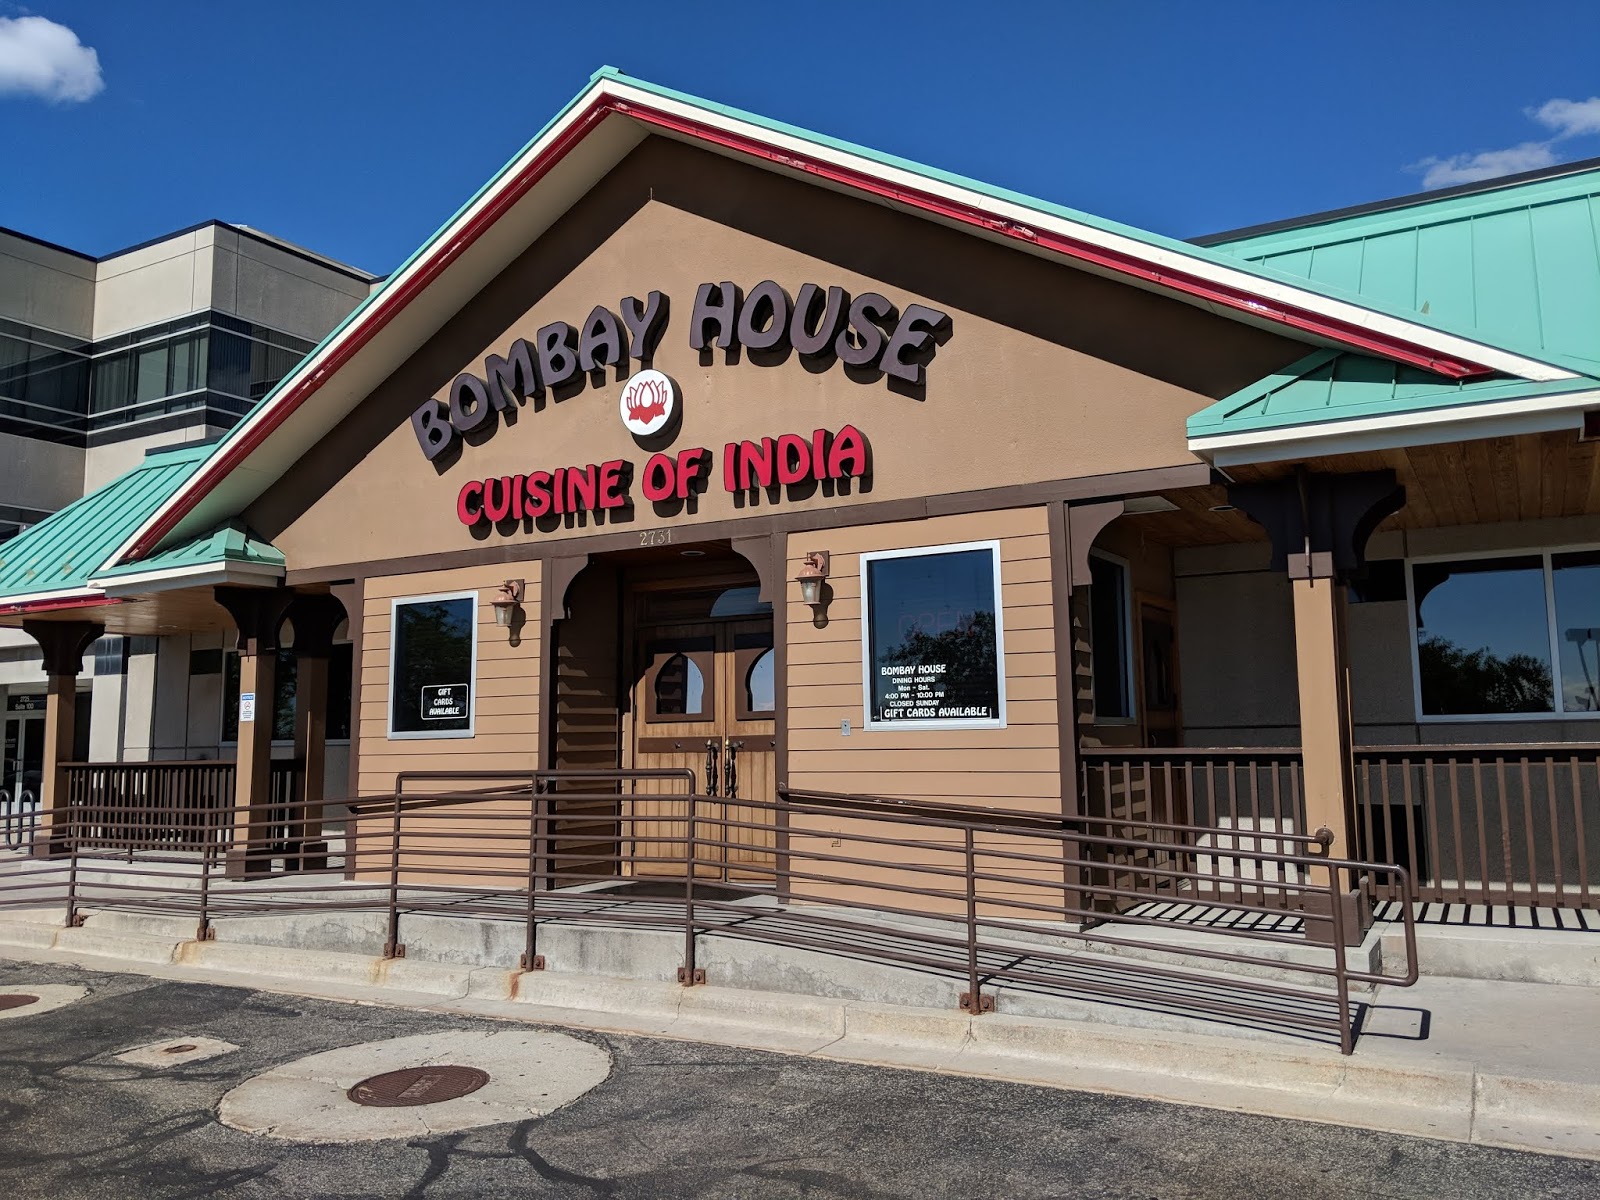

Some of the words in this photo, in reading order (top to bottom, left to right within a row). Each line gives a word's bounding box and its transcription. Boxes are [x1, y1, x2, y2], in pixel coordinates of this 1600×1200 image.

[410, 290, 670, 462] BOMBAY
[690, 280, 953, 386] HOUSE
[456, 459, 627, 526] CUISINE
[642, 447, 704, 502] OF
[723, 424, 867, 493] INDIA
[640, 529, 672, 546] 2731
[881, 666, 916, 676] BOMBAY
[918, 664, 947, 674] HOUSE
[437, 688, 452, 696] GIFT
[917, 691, 933, 699] 10:00
[433, 698, 453, 706] CARDS
[429, 707, 460, 715] AVAILABLE
[884, 708, 904, 718] GIFT
[906, 708, 936, 717] CARDS
[938, 706, 988, 717] AVAILABLE
